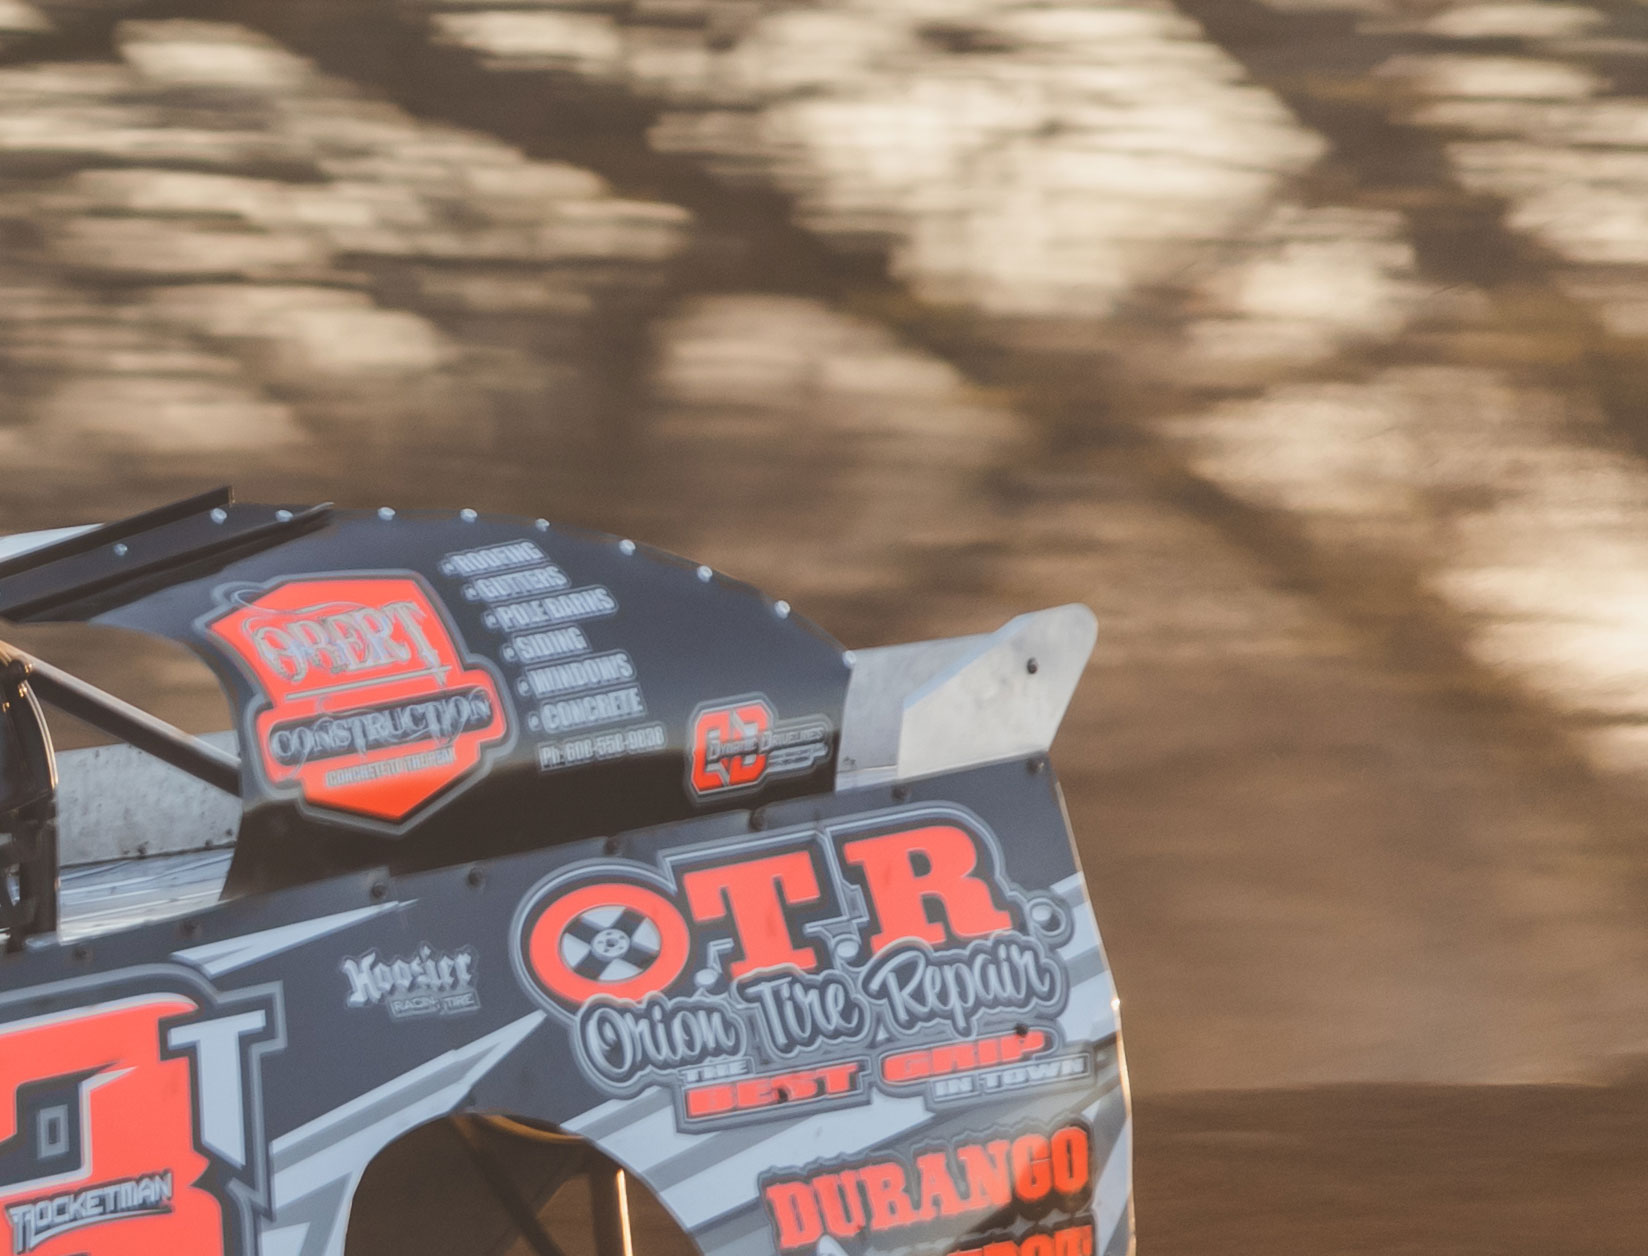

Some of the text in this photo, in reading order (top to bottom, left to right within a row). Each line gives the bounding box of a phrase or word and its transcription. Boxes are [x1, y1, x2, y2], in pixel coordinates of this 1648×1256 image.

[450, 541, 545, 574] ROOFING
[474, 566, 569, 598] GUTTERS
[494, 588, 616, 631] POLE BARNS
[513, 627, 588, 659] SIDING
[529, 653, 634, 694] WINDOWS
[271, 694, 492, 758] CONSTRUCTION
[542, 687, 644, 729] CONCRETE
[586, 944, 1050, 1068] Orion Tire Repair
[684, 1060, 749, 1083] THE
[882, 1029, 1046, 1083] GRIP
[934, 1056, 1087, 1099] IN TOWN
[687, 1063, 860, 1119] BEST
[765, 1126, 1090, 1250] DURANGO
[8, 1173, 174, 1254] ROCKETMAN
